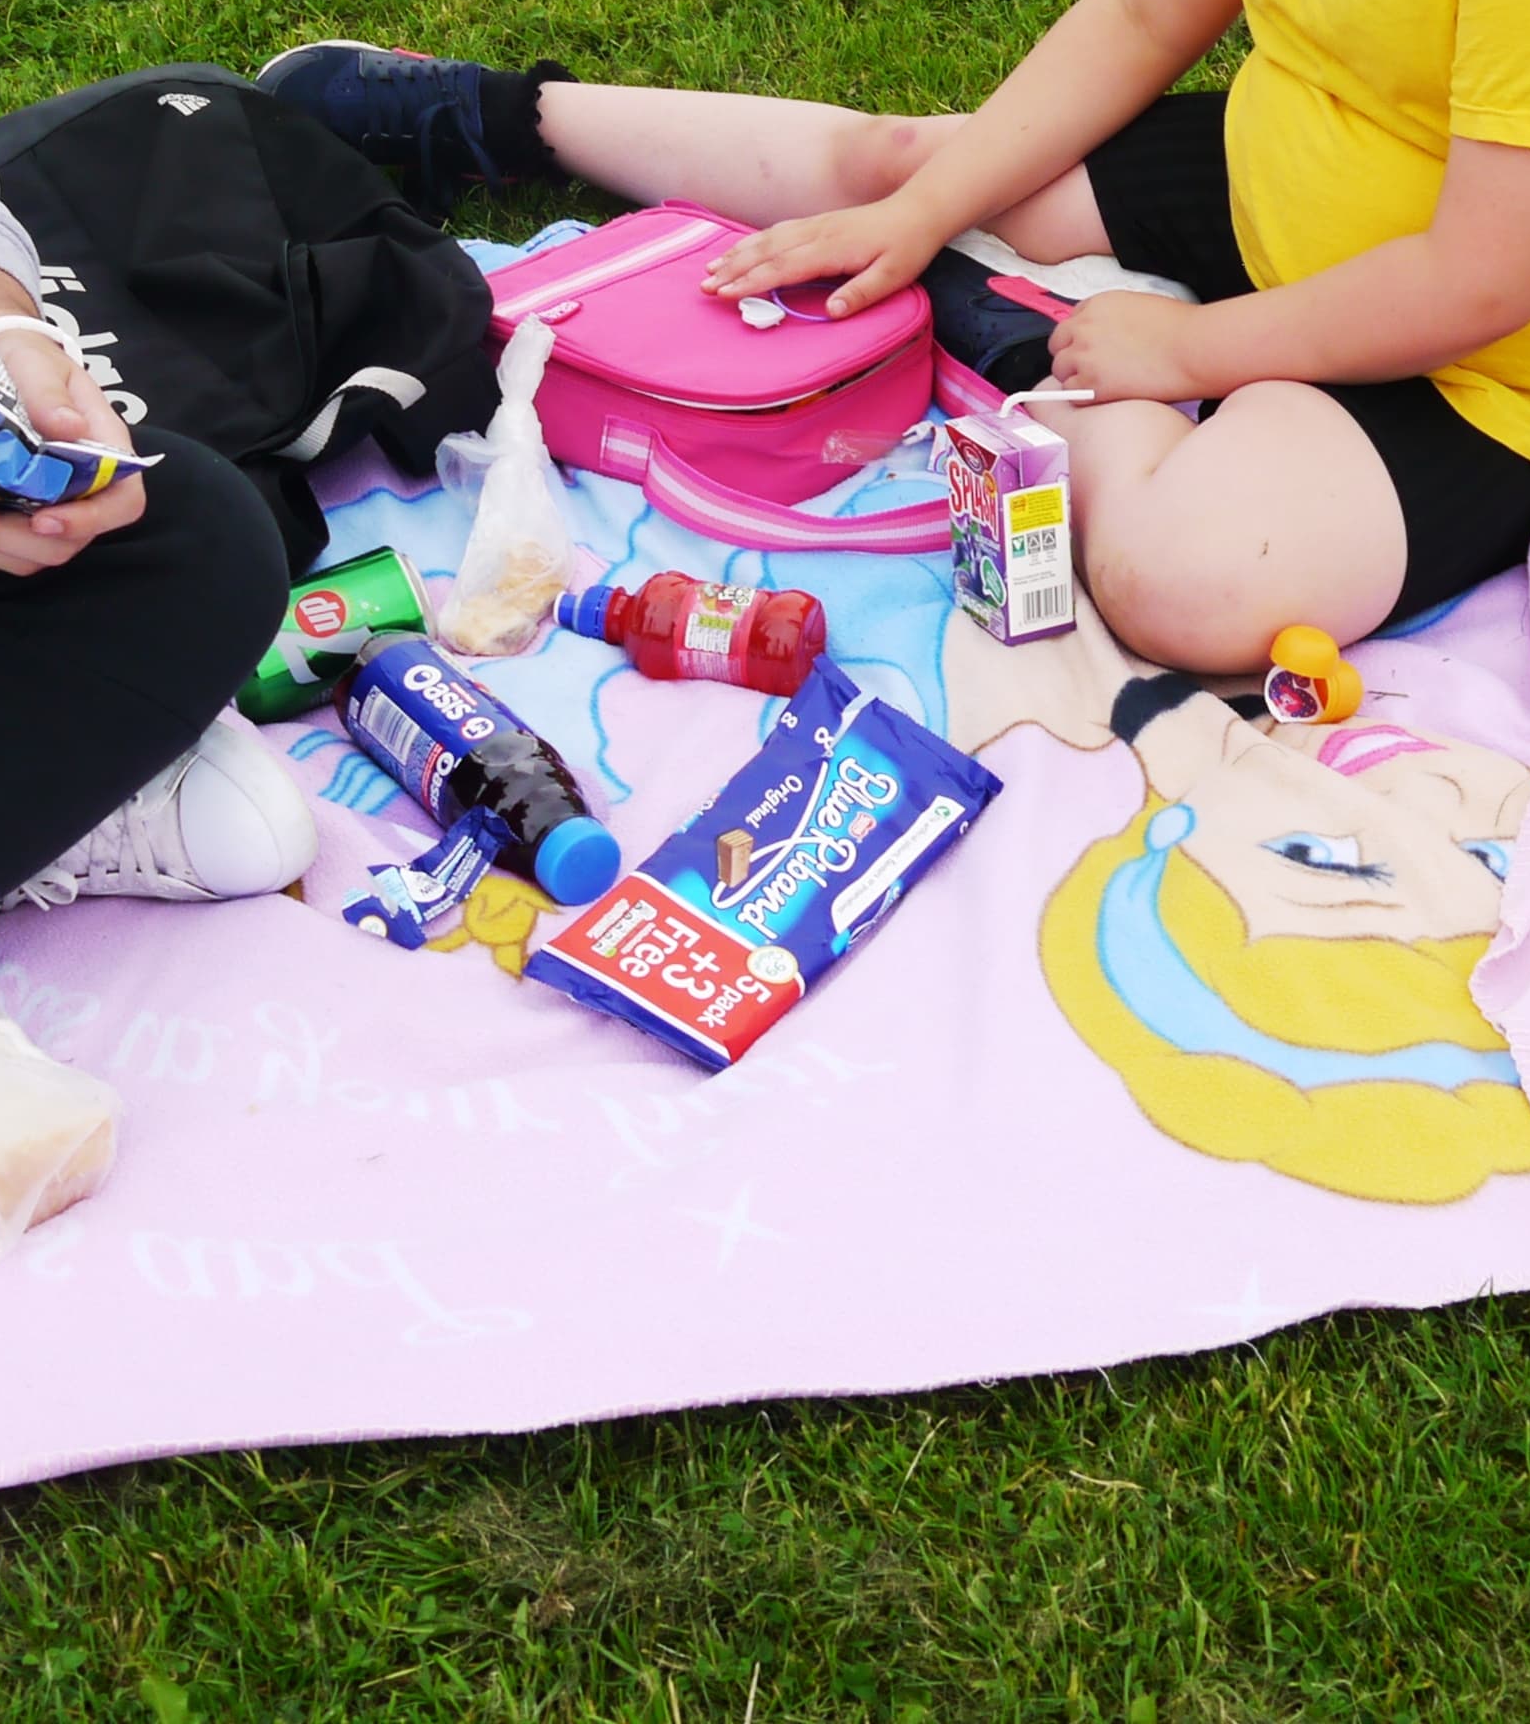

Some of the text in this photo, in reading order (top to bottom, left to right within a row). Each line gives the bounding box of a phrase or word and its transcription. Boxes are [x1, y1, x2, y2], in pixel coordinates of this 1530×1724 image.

[947, 459, 999, 541] SPLASH
[402, 663, 474, 724] Oasis
[744, 773, 804, 830] Original
[816, 755, 899, 830] Blue
[735, 834, 859, 941] Riband
[618, 916, 701, 980] Free
[661, 949, 722, 1000] +3
[698, 974, 773, 1030] 5 pack
